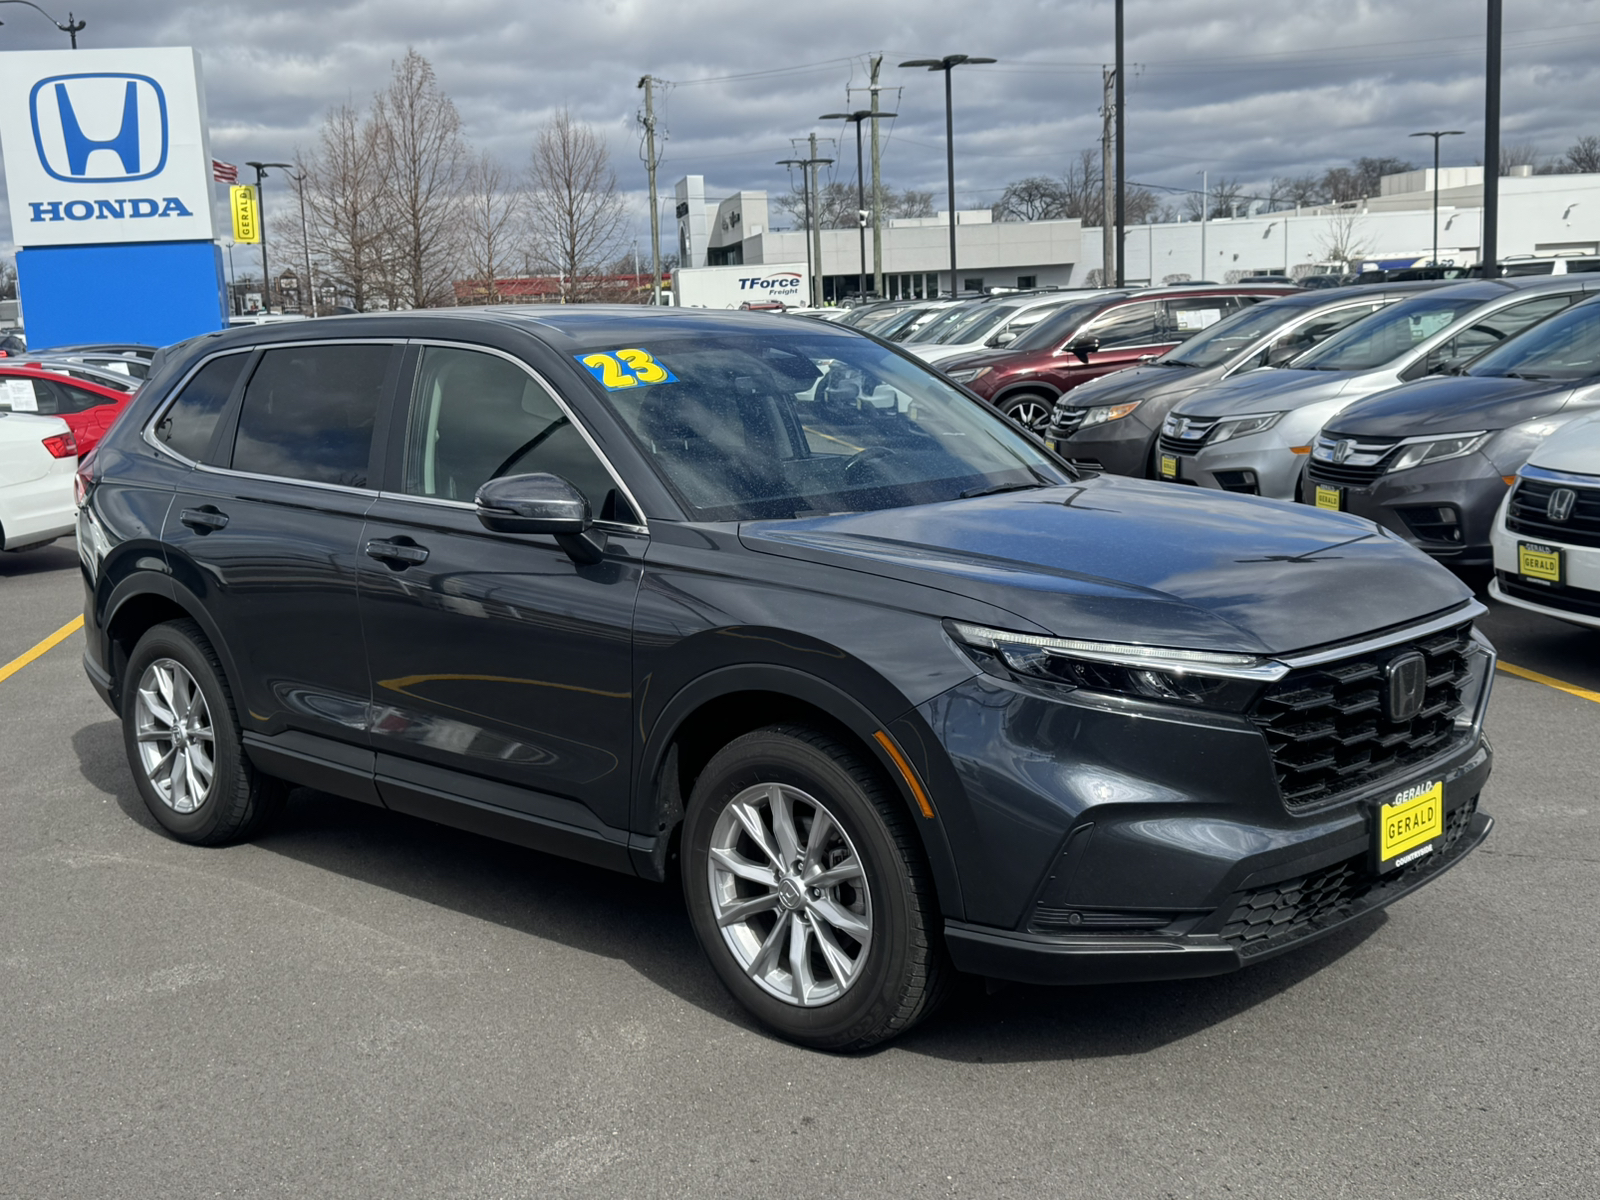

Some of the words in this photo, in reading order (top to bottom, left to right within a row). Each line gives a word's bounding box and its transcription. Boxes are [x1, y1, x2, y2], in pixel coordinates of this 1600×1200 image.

[28, 197, 193, 222] HONDA
[239, 192, 250, 235] GERALD
[738, 277, 800, 290] TForce
[769, 288, 798, 296] Freight
[582, 348, 668, 388] 23
[1525, 558, 1555, 571] GERALD
[1388, 806, 1434, 839] GERALD
[1395, 844, 1433, 867] COUNTRYSIDE
